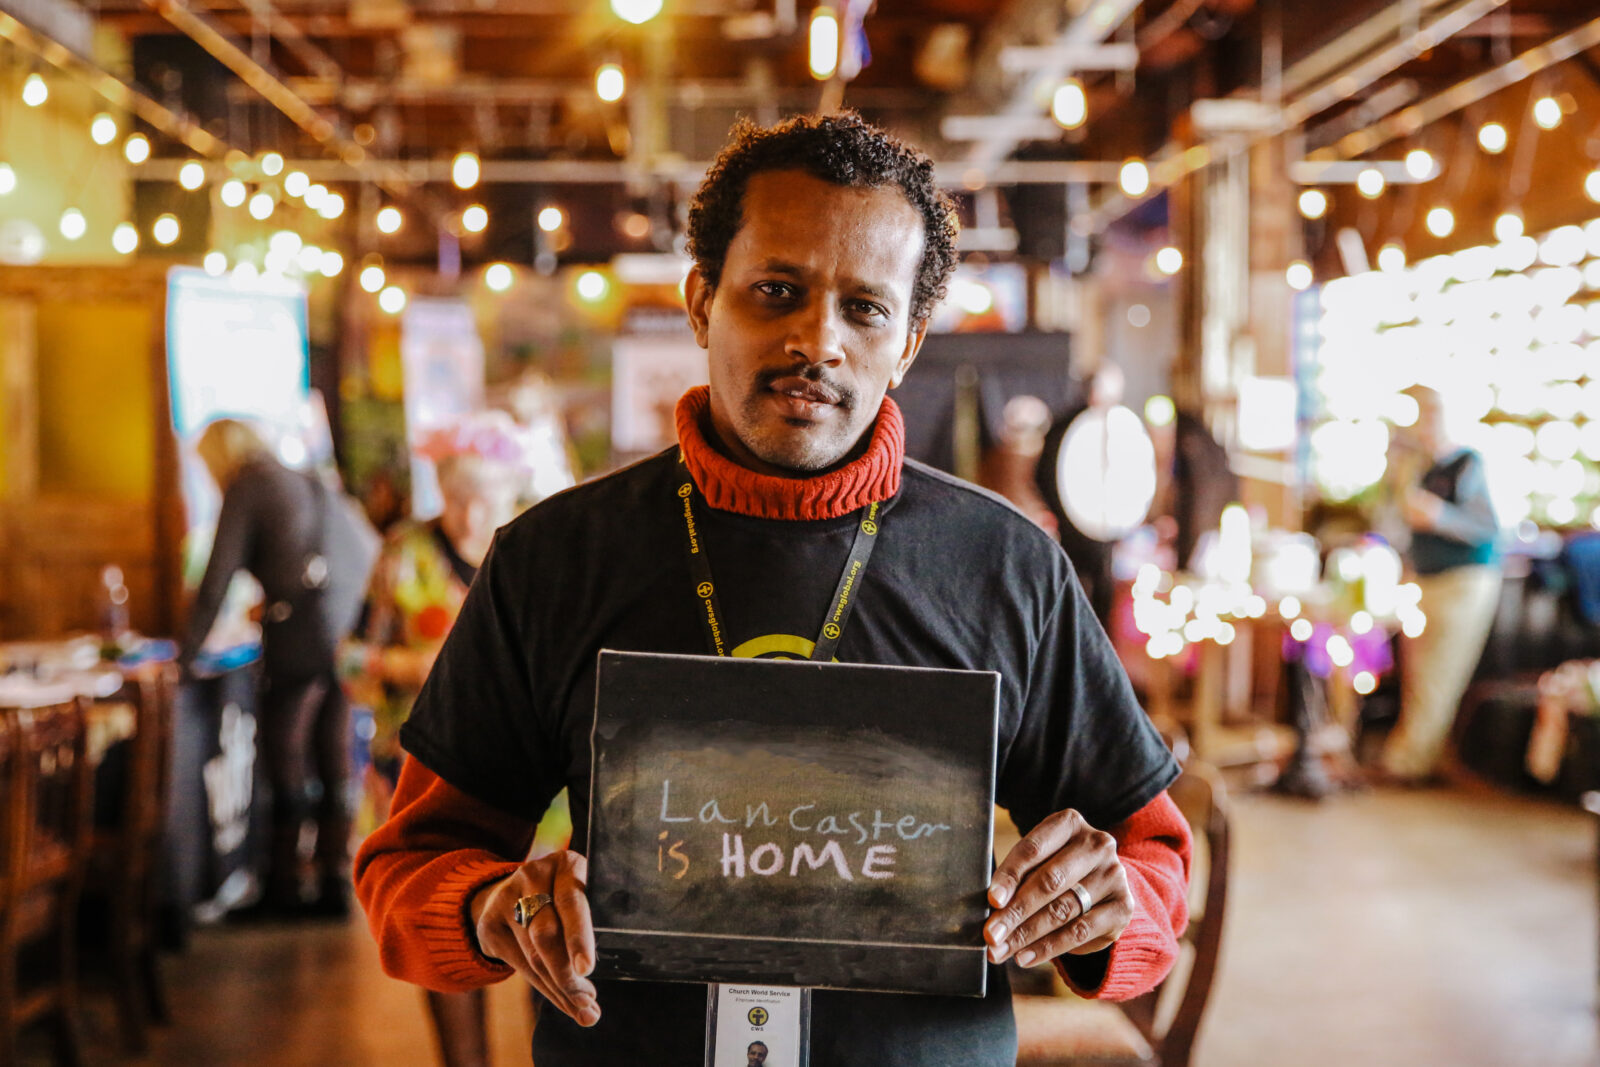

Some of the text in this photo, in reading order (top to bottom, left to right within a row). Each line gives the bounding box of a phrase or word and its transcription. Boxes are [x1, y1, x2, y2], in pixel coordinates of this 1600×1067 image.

[683, 497, 699, 554] cwsglobal.org
[833, 560, 862, 622] cwsglobal.org
[705, 599, 725, 657] cwsglobal.or
[658, 830, 898, 881] is HOME
